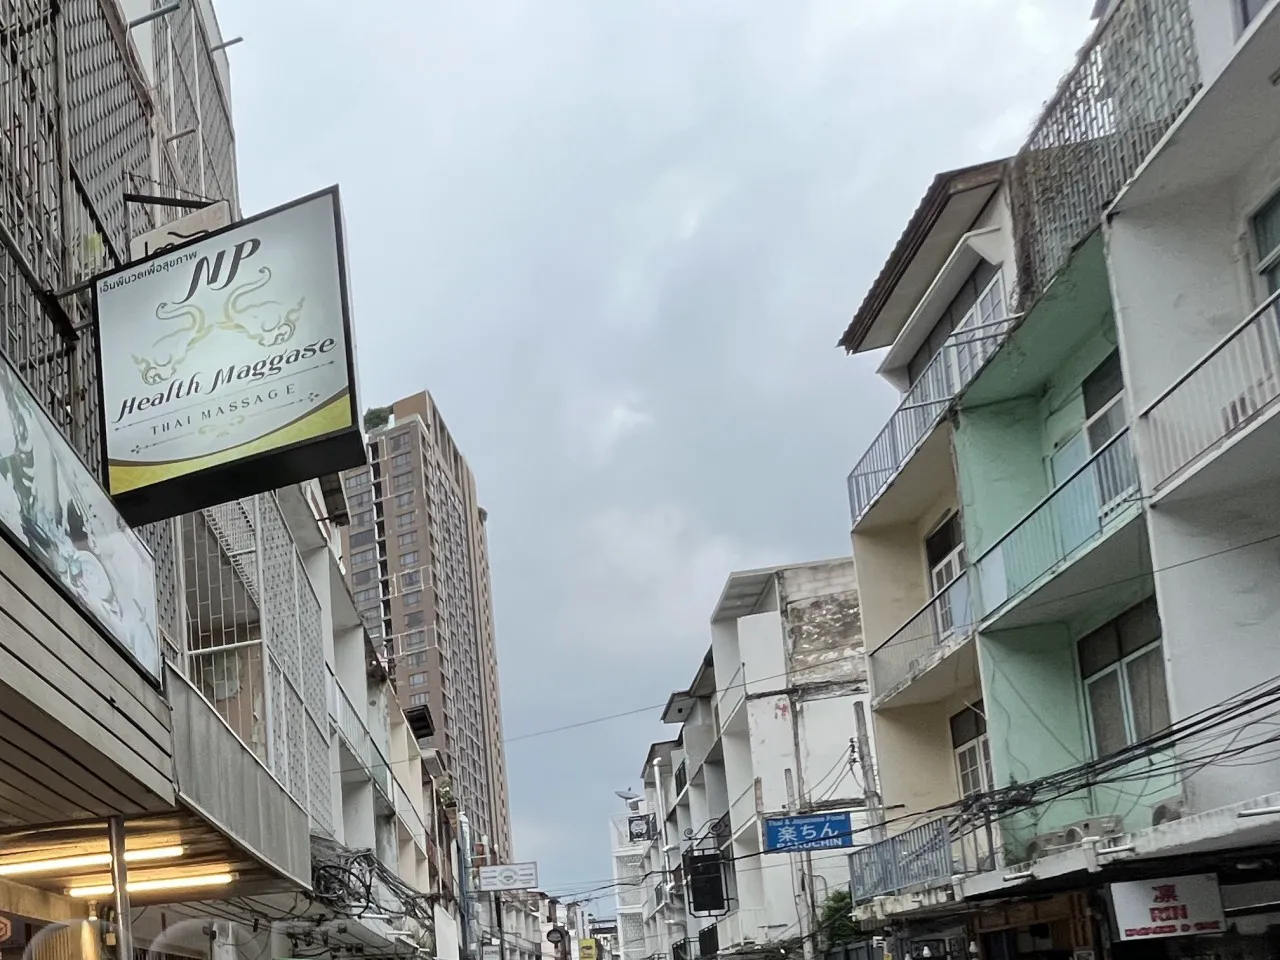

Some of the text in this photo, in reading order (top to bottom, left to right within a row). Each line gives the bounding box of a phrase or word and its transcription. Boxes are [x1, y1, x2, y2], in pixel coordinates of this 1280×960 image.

[172, 238, 261, 305] NP
[112, 337, 337, 424] Health Maggase
[150, 383, 297, 436] THAI MASSAGE
[777, 823, 839, 842] 楽ちん
[1150, 904, 1188, 922] RIN
